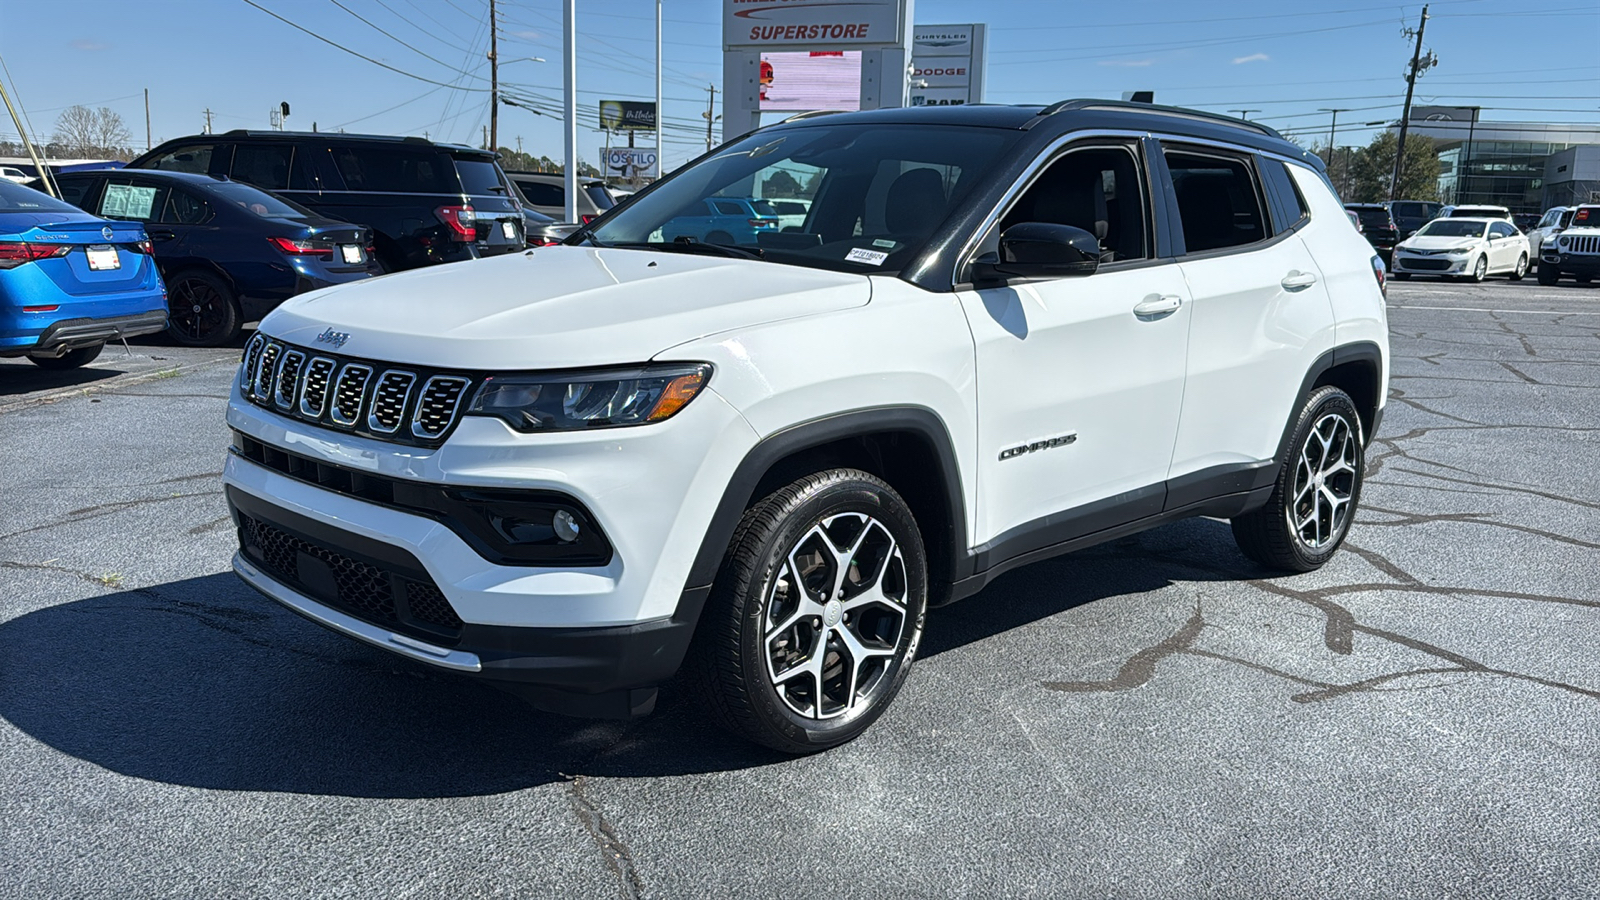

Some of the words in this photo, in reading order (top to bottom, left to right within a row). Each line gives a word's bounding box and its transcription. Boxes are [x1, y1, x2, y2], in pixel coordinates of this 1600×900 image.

[750, 24, 869, 40] SUPERSTORE
[913, 68, 966, 76] DODGE
[602, 153, 656, 164] HOSTILO
[316, 326, 350, 348] Jeep
[998, 433, 1077, 461] COMPASS
